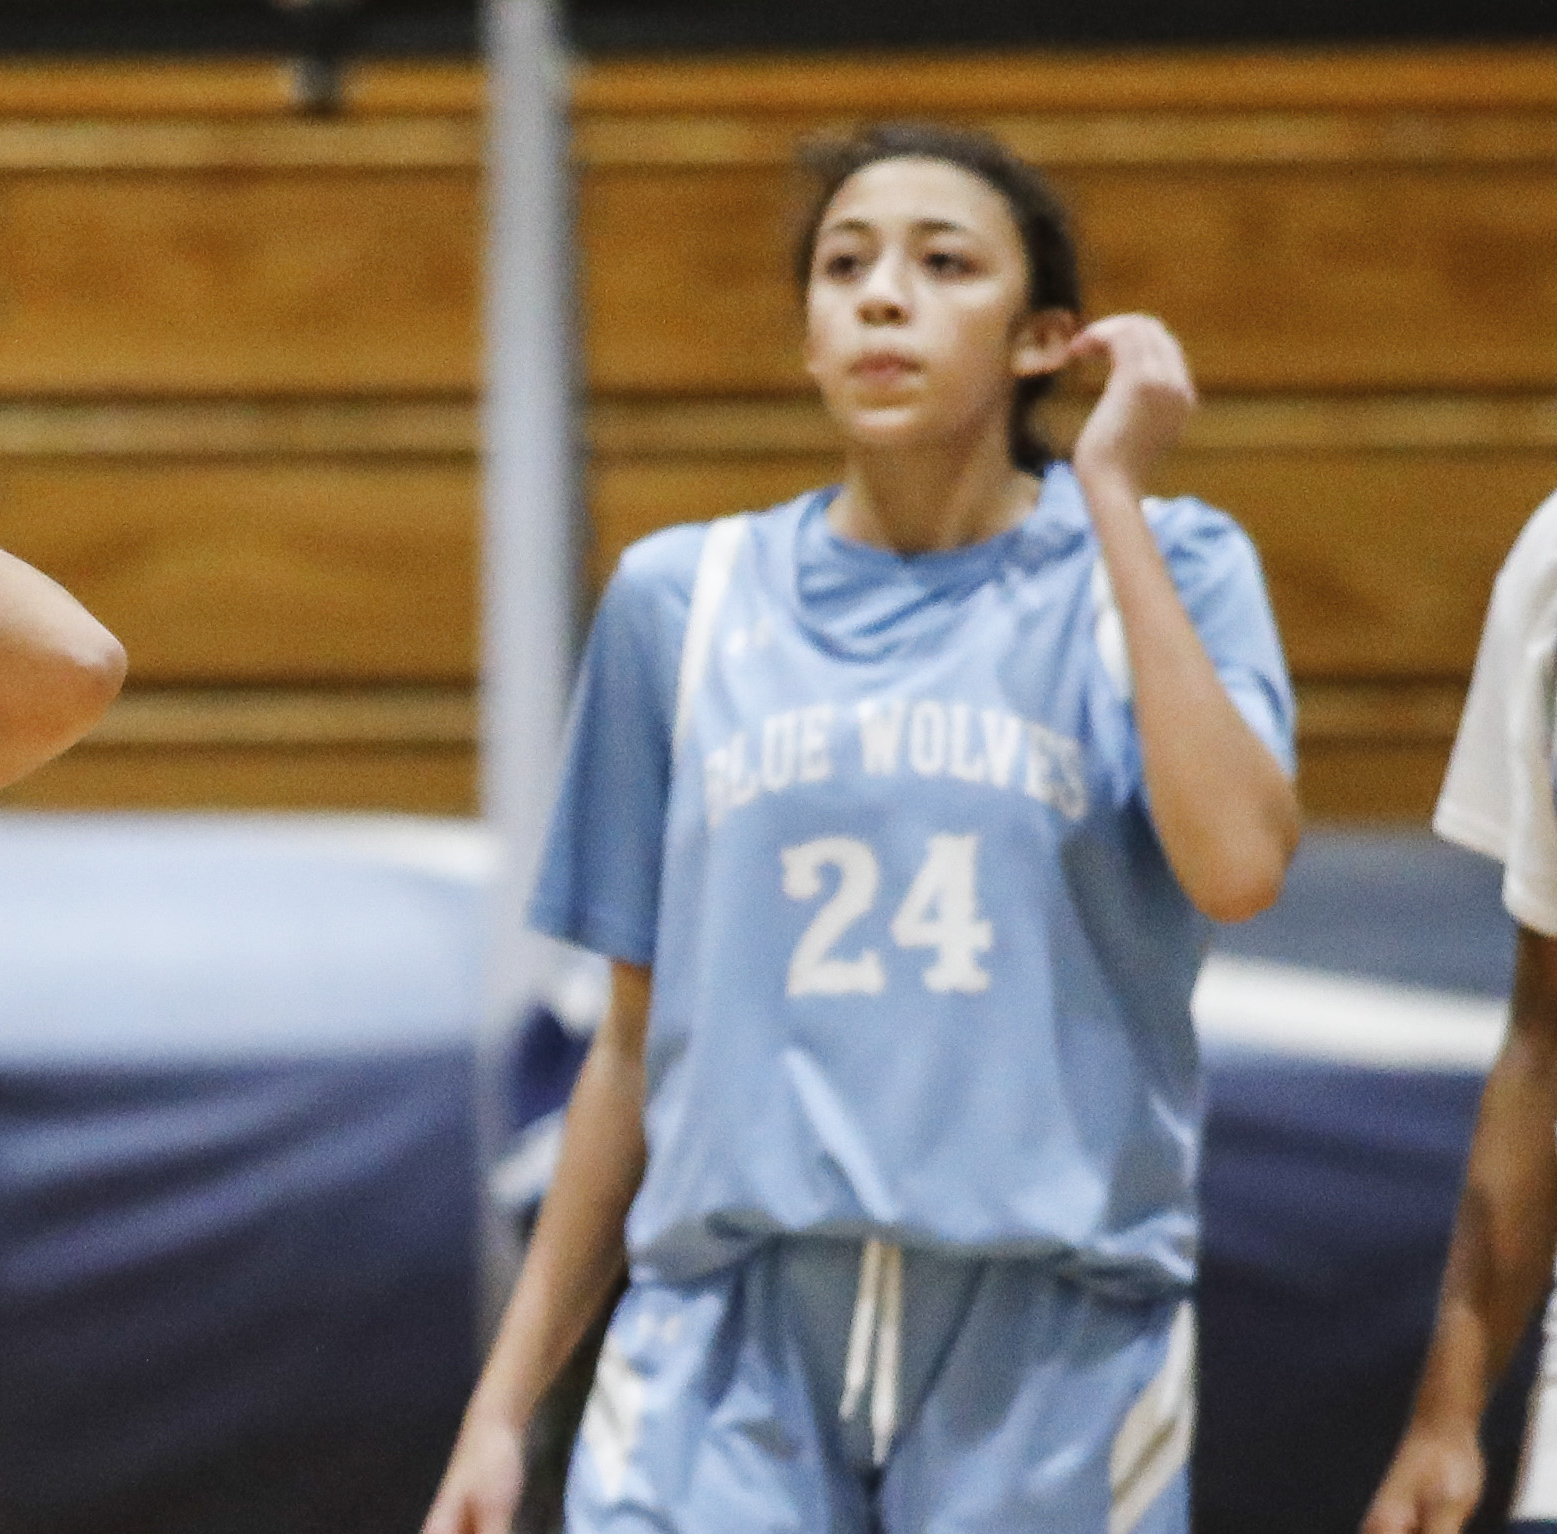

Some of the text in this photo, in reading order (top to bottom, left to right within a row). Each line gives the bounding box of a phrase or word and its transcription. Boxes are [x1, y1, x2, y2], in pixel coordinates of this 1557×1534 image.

[704, 697, 1088, 828] BLUE WOLVES
[783, 833, 993, 997] 24
